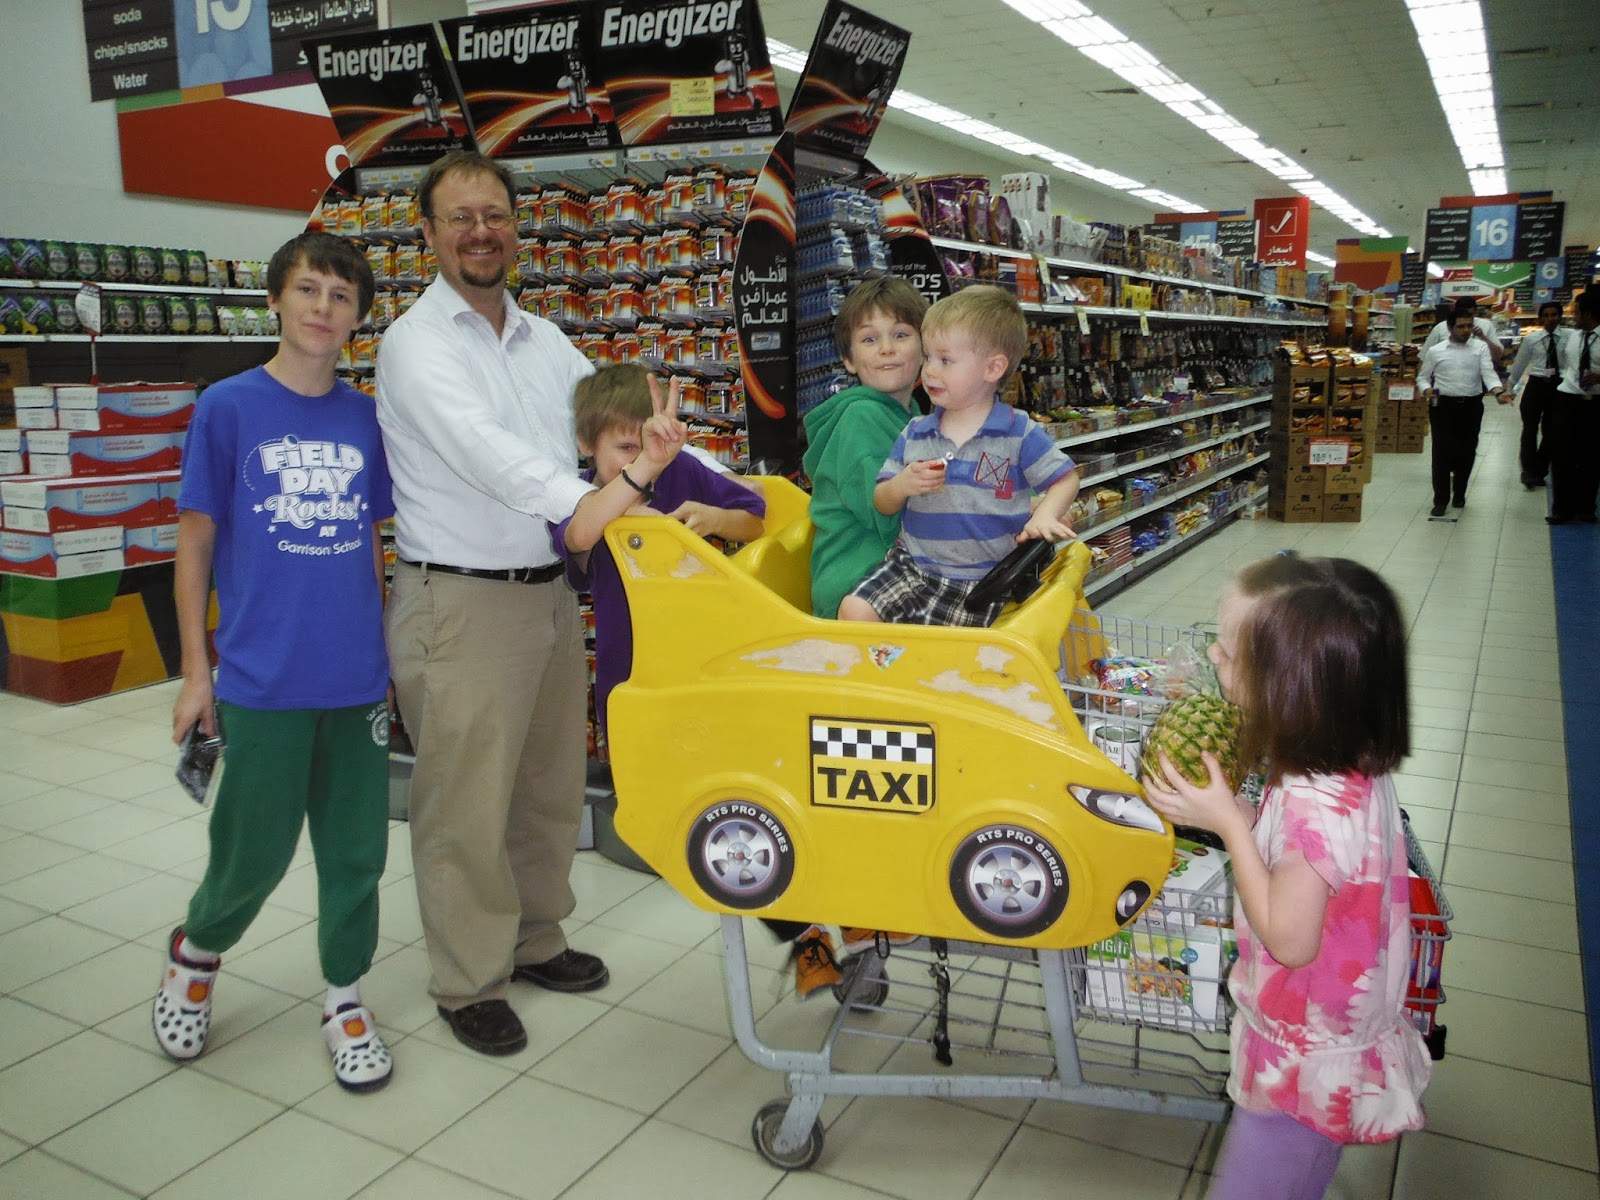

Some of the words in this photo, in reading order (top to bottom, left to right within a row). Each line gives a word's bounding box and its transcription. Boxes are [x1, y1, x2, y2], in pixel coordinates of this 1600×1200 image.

[113, 9, 142, 25] soda
[601, 0, 743, 48] Energizer
[94, 36, 168, 60] chips/snacks
[458, 18, 579, 64] Energizer
[825, 12, 905, 66] Energizer
[318, 40, 428, 81] Energizer
[113, 72, 148, 90] Water
[1476, 218, 1509, 247] 16
[1452, 285, 1480, 293] BATTERIES
[742, 307, 788, 329] العالم
[280, 467, 355, 495] DAY
[264, 493, 361, 530] Rocks!
[278, 540, 330, 555] Garrison
[333, 538, 362, 555] School
[817, 767, 928, 806] TAXI
[706, 806, 729, 822] RTS
[732, 805, 756, 816] PRO
[759, 813, 788, 853] SERIES
[977, 829, 1002, 844] RTS
[1007, 830, 1033, 845] PRO
[1035, 843, 1062, 887] SERIES
